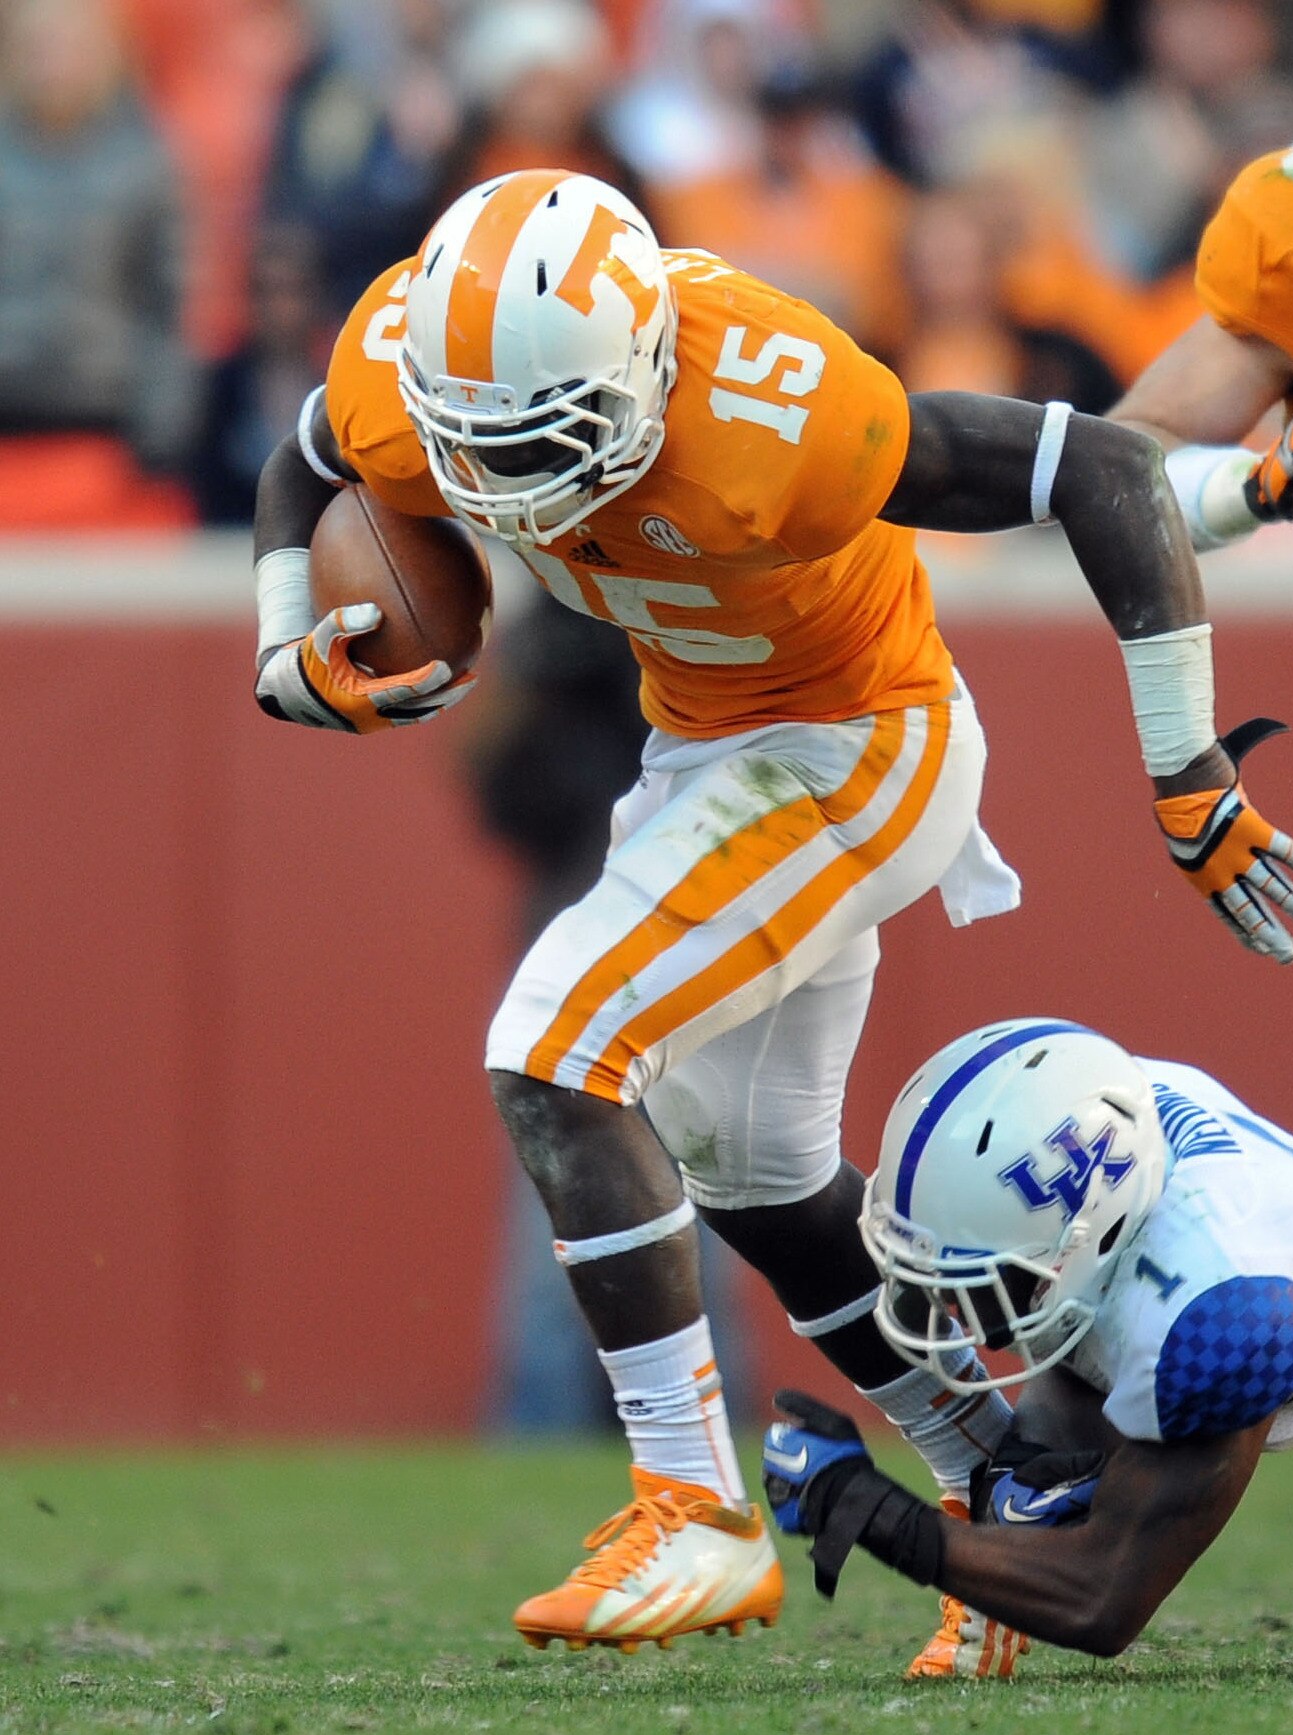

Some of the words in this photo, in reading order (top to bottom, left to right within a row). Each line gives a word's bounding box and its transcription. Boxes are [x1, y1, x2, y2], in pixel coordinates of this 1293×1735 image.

[459, 385, 479, 404] T
[708, 326, 828, 446] 15
[998, 1115, 1138, 1224] UK
[1136, 1253, 1187, 1303] 1
